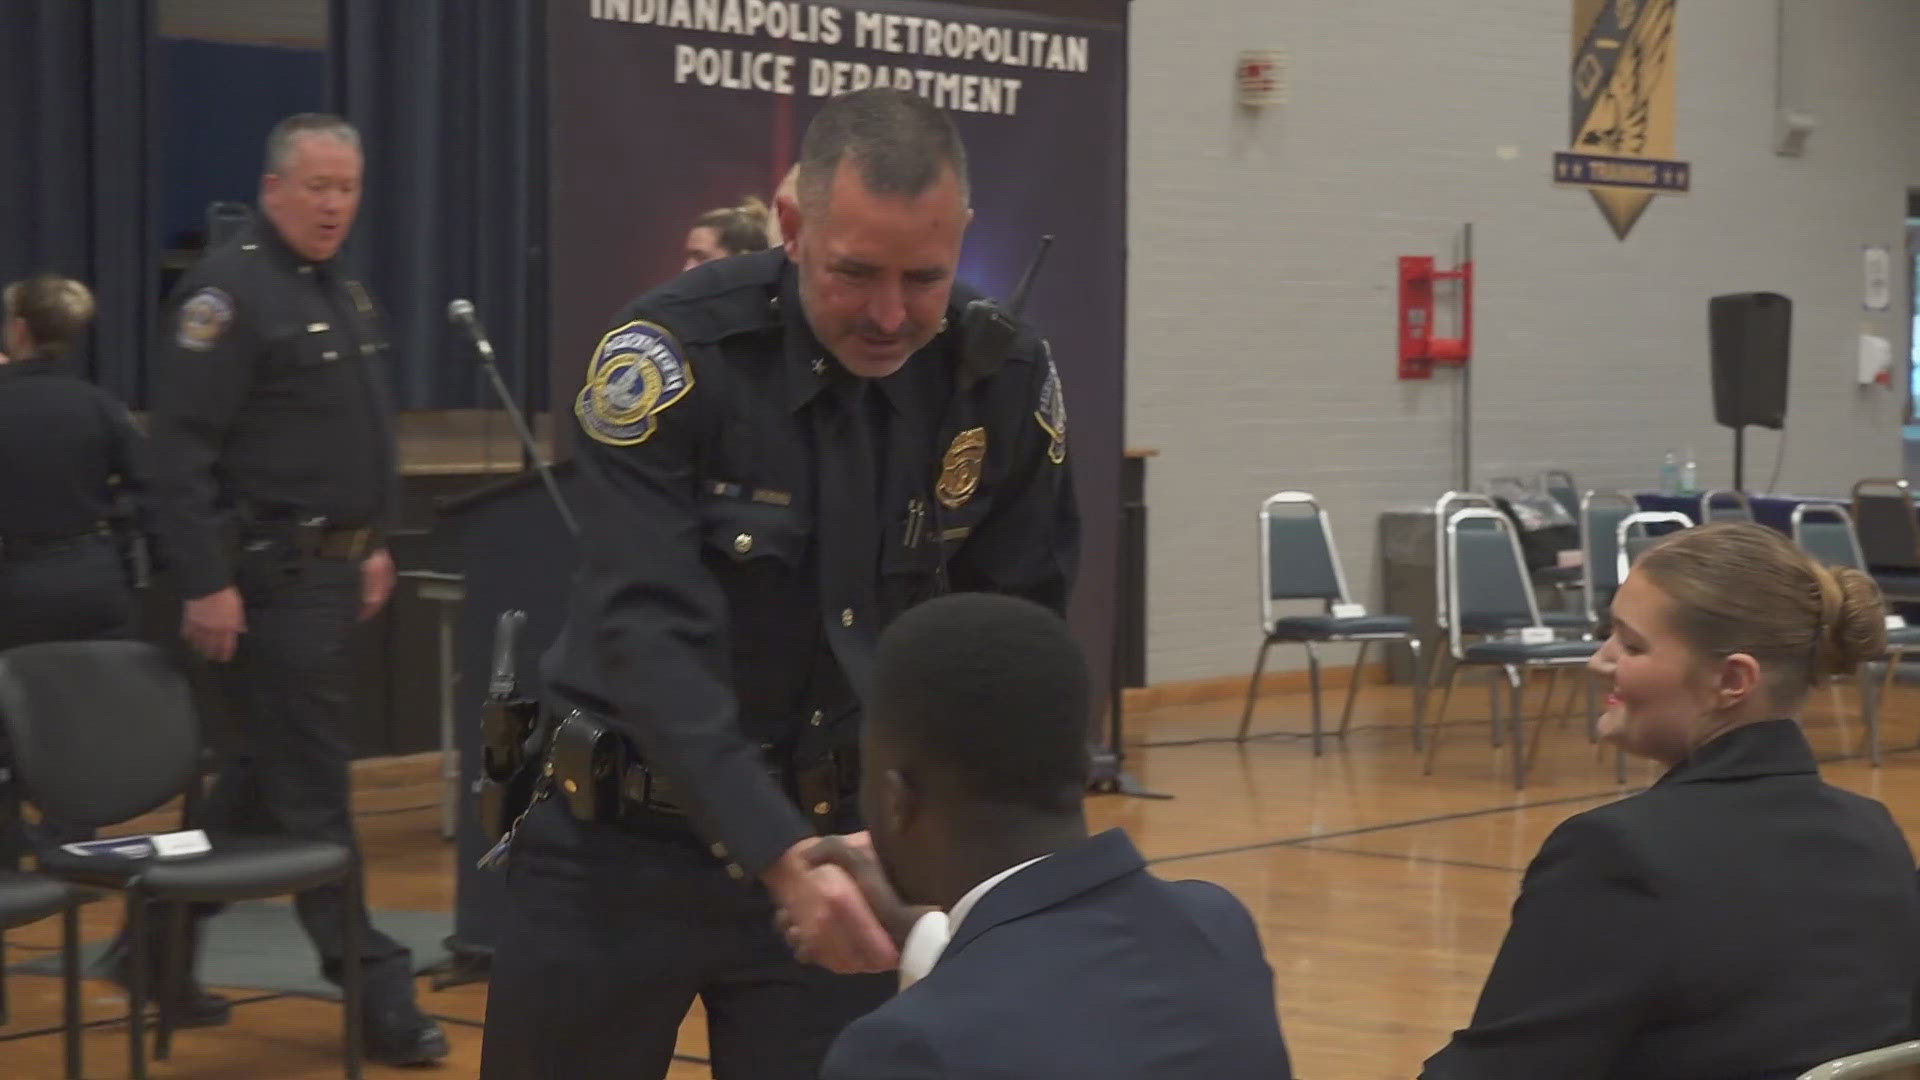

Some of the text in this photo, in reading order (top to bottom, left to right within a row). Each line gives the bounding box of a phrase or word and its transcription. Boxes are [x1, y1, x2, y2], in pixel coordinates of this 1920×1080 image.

[855, 10, 1089, 73] METROPOLITAN
[674, 44, 1022, 116] POLICE DEPARTMENT
